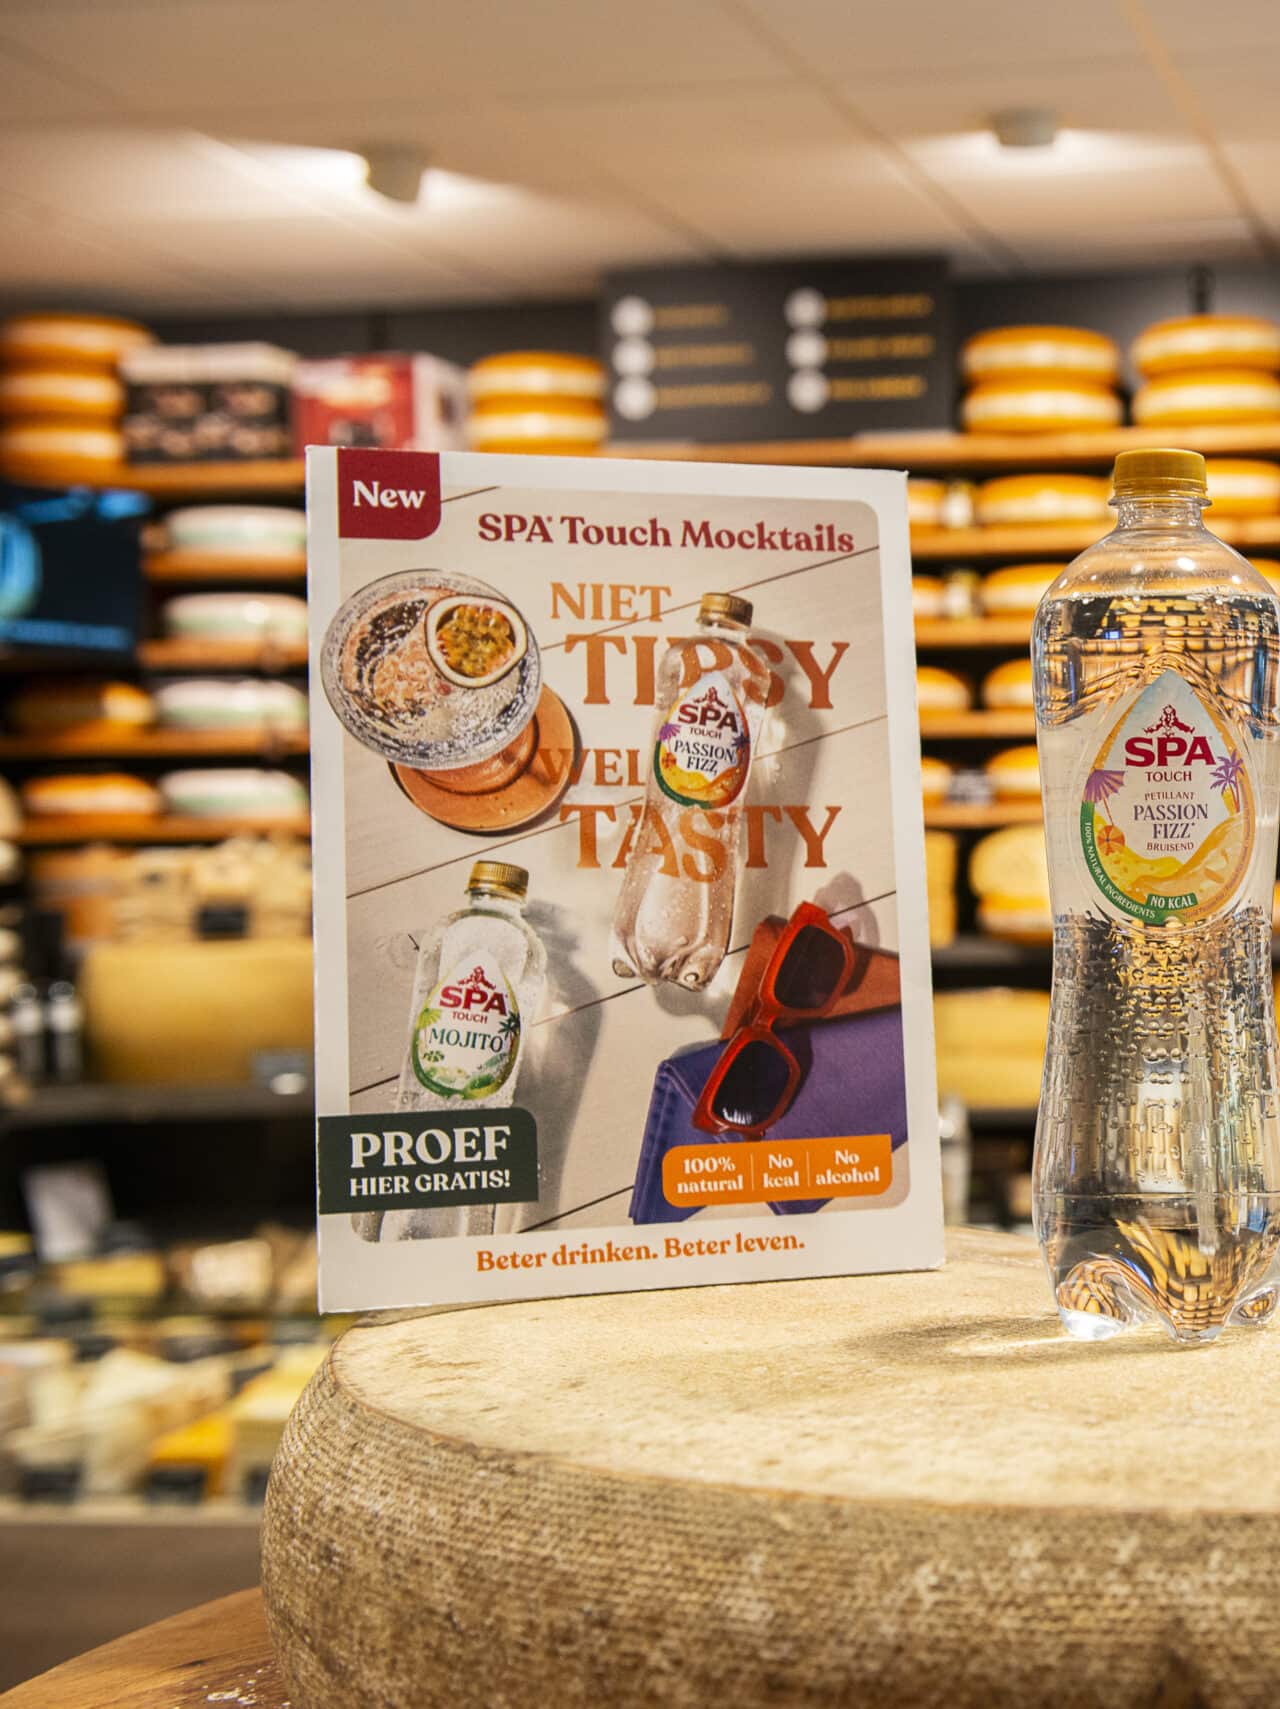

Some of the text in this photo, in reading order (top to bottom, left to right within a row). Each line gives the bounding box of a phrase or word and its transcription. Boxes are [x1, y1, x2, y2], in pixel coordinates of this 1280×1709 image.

[353, 480, 426, 509] New
[560, 516, 672, 545] Touch
[680, 520, 855, 553] Mocktails
[550, 582, 672, 622] NIET
[564, 634, 850, 709] TIPSY
[678, 703, 738, 732] SPA
[690, 727, 722, 739] TOUCH
[674, 740, 735, 764] PASSION
[1124, 736, 1216, 767] SPA
[536, 748, 646, 787] WEL
[1145, 771, 1192, 782] TOUCH
[1133, 803, 1209, 821] PASSION
[559, 804, 843, 883] TASTY
[1146, 842, 1194, 852] BRUISEND
[1085, 822, 1156, 919] 100% NATURAL INGREDIENTS
[1150, 894, 1194, 909] NO KCAL
[439, 985, 508, 1016] SPA
[452, 1010, 488, 1024] TOUCH
[428, 1027, 503, 1053] MOJITO
[350, 1125, 511, 1168] PROEF
[834, 1149, 860, 1166] No
[683, 1156, 736, 1175] 100%
[768, 1153, 793, 1169] No
[350, 1168, 511, 1197] HIER GRATIS!
[677, 1175, 744, 1194] natural
[763, 1172, 800, 1189] kcal
[815, 1166, 880, 1185] alcohol
[476, 1231, 805, 1271] Beter drinken. Beter leven.
